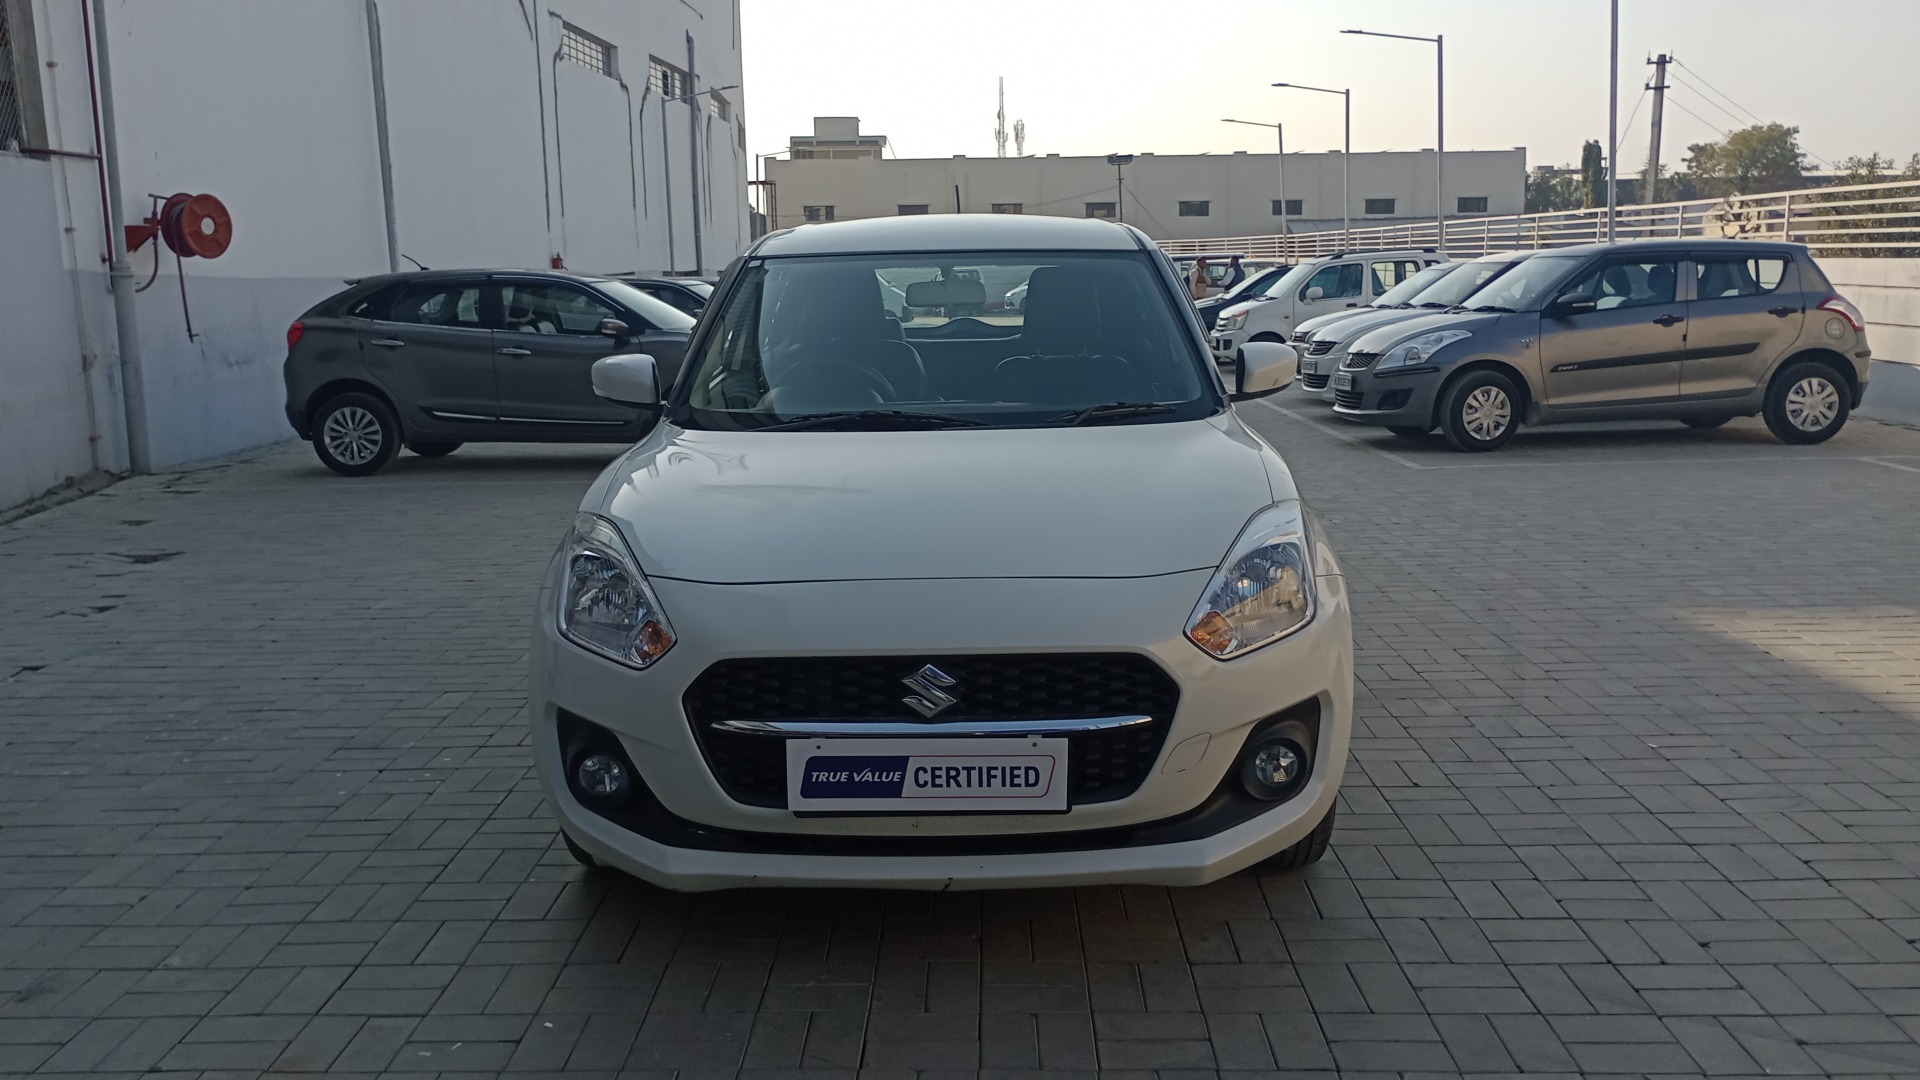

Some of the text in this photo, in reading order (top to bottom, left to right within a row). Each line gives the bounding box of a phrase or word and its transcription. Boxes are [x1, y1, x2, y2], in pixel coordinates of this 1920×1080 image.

[811, 766, 1040, 788] TRUE VALUE CERTIFIED
